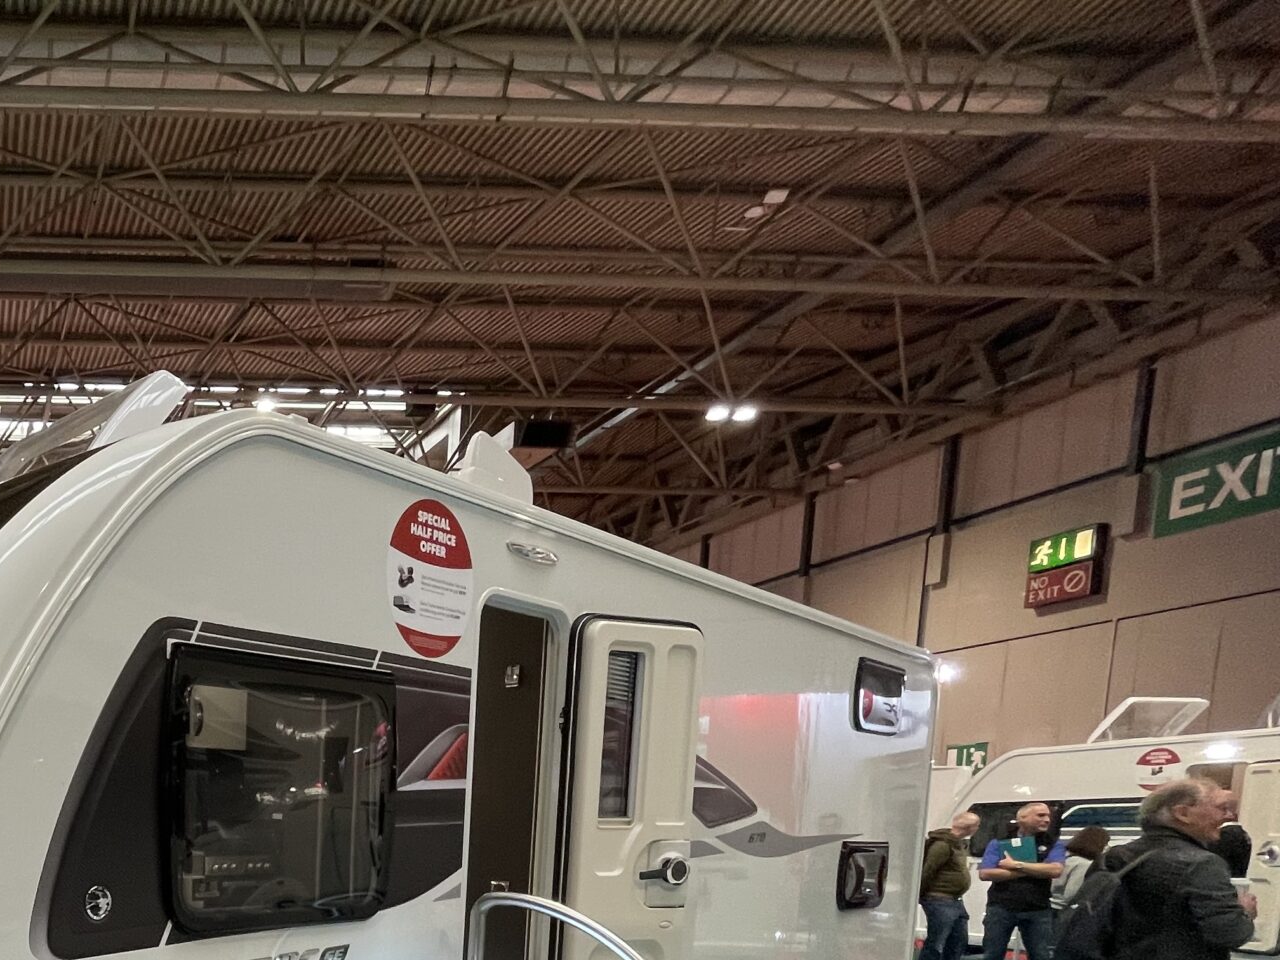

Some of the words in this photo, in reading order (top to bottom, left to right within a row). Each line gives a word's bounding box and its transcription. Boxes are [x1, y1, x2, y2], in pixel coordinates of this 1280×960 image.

[1169, 446, 1280, 520] EXI
[418, 510, 451, 531] SPECIAL
[410, 522, 432, 539] HALF
[433, 529, 456, 547] PRICE
[420, 540, 447, 559] OFFER
[1029, 576, 1049, 590] NO
[1028, 585, 1061, 603] EXIT
